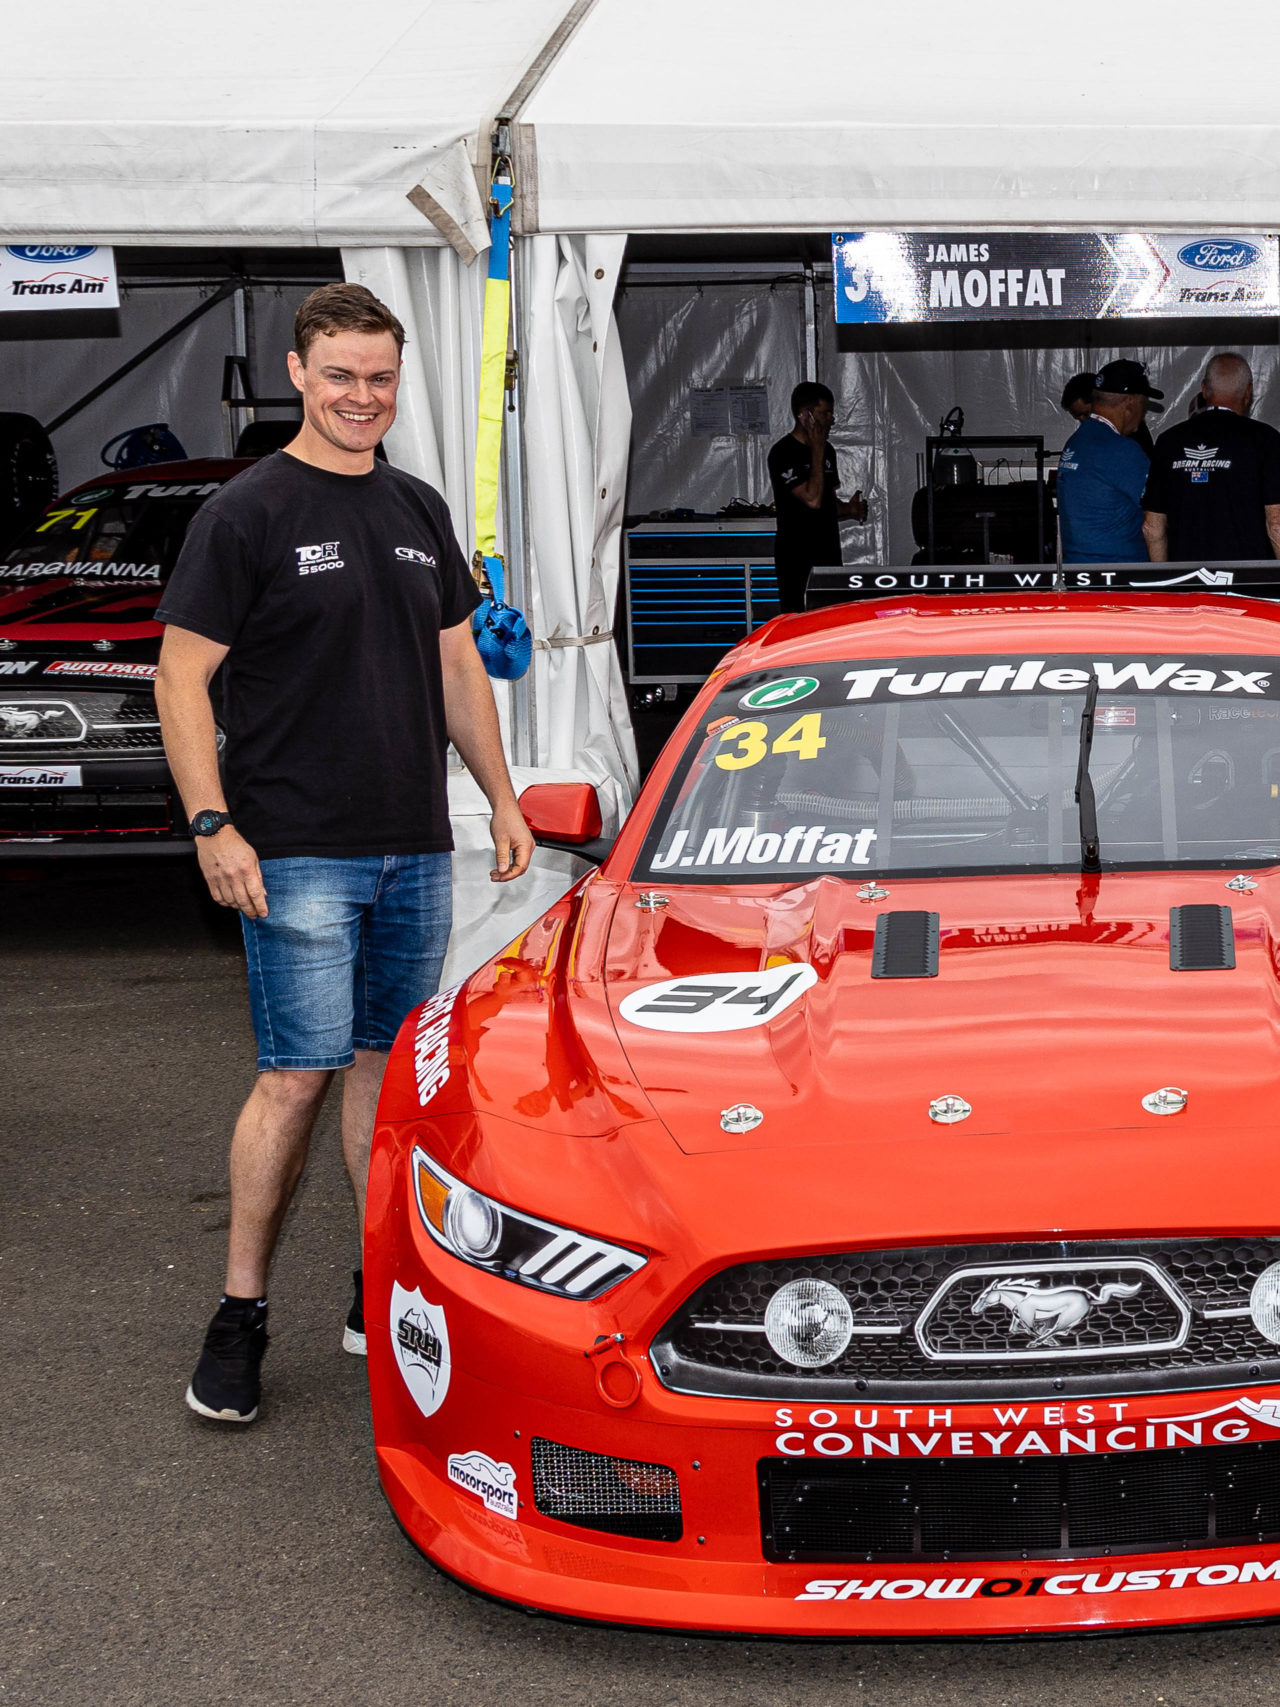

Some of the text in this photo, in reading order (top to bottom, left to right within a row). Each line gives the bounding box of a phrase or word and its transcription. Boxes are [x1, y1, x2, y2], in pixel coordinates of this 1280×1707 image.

[926, 244, 989, 262] JAMES
[1194, 244, 1246, 266] Ford
[12, 279, 104, 295] Trans Am
[930, 268, 1065, 307] MOFFAT
[1179, 288, 1229, 302] Trans
[1173, 460, 1231, 469] DREAM RACING
[36, 508, 98, 532] 71
[296, 542, 340, 562] TCR
[395, 547, 436, 565] GRM
[299, 561, 344, 575] S5000
[849, 572, 1117, 588] SOUTH WEST
[58, 662, 109, 671] AUTO
[715, 713, 827, 771] 34
[36, 773, 64, 785] Am
[650, 825, 878, 869] J.Moffat
[634, 970, 804, 1016] 34
[414, 1013, 451, 1107] RACING
[777, 1403, 1128, 1428] SOUTH WEST
[776, 1419, 1250, 1457] CONVEYANCING
[450, 1464, 514, 1505] motorsport
